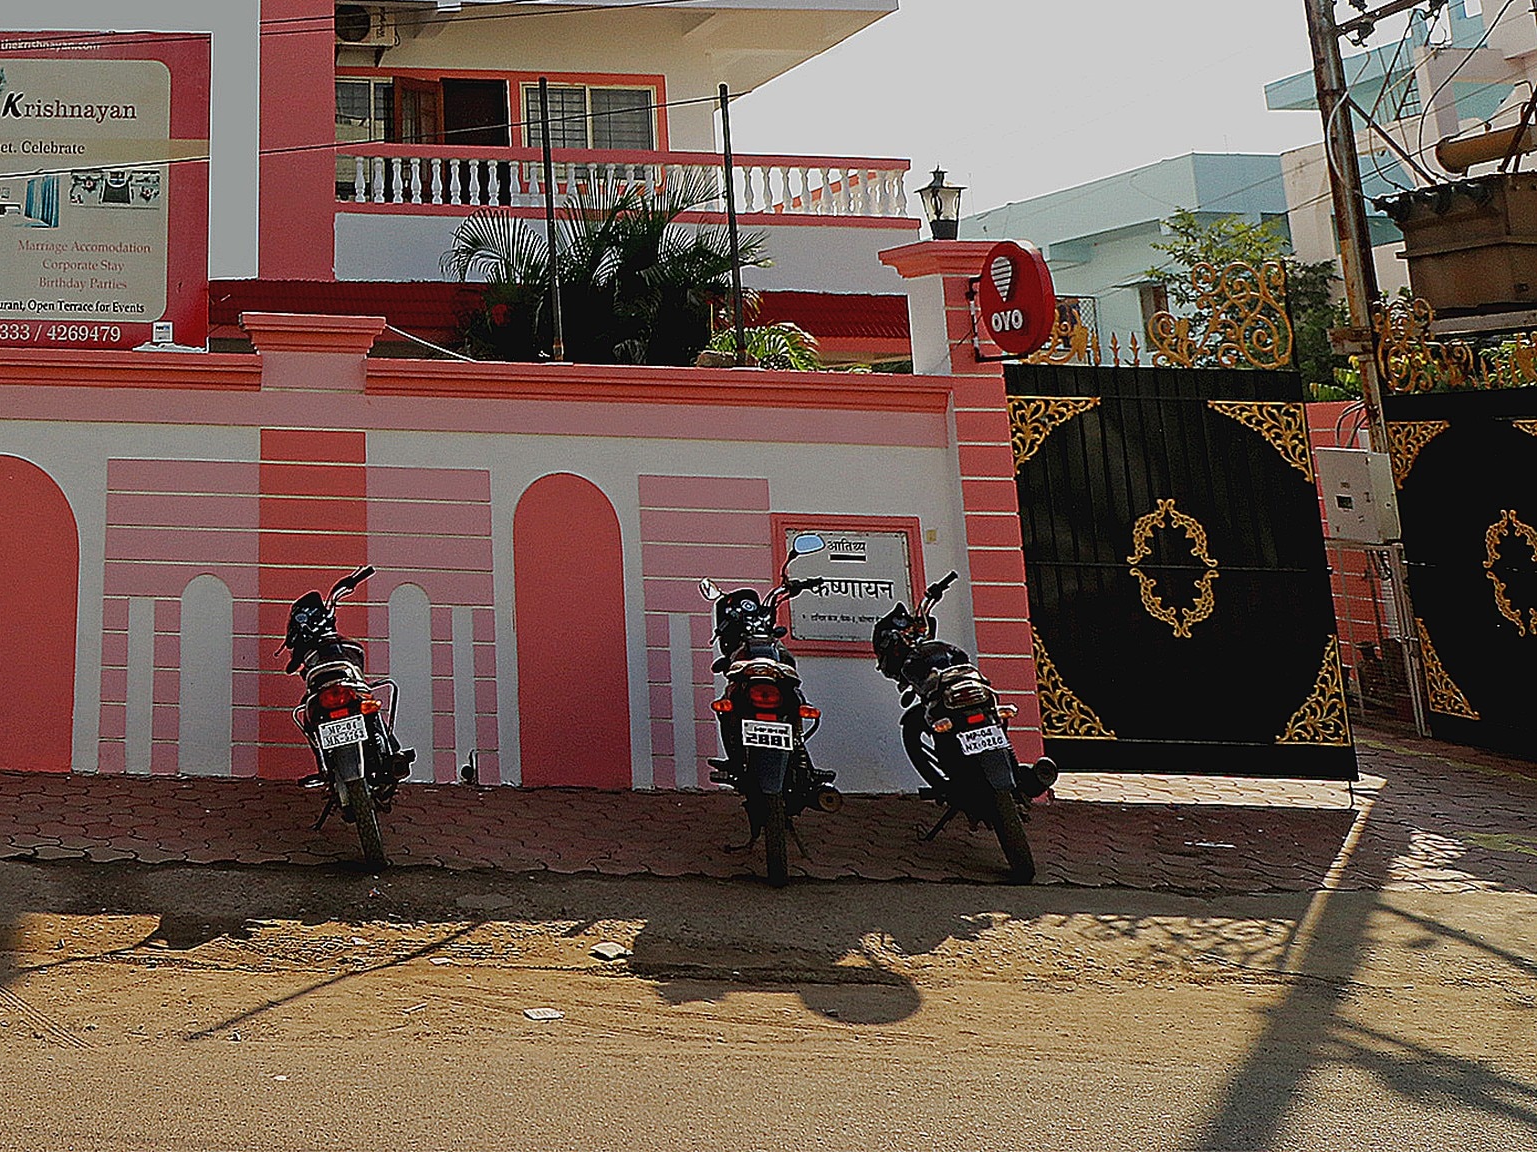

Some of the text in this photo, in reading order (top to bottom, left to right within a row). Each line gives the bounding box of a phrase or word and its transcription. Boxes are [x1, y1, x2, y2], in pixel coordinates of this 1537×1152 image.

[1, 92, 137, 123] Krishnayan
[21, 140, 85, 154] Celebrate
[18, 239, 151, 254] Marriage Accomodation
[42, 259, 125, 274] Corporate Stay
[39, 277, 128, 292] Birthday Parties
[27, 300, 55, 313] Open
[57, 300, 94, 312] Terrace
[95, 301, 111, 312] for
[112, 302, 145, 313] Events
[991, 309, 1023, 332] OYO
[34, 325, 42, 341] /
[47, 325, 121, 342] 4269479
